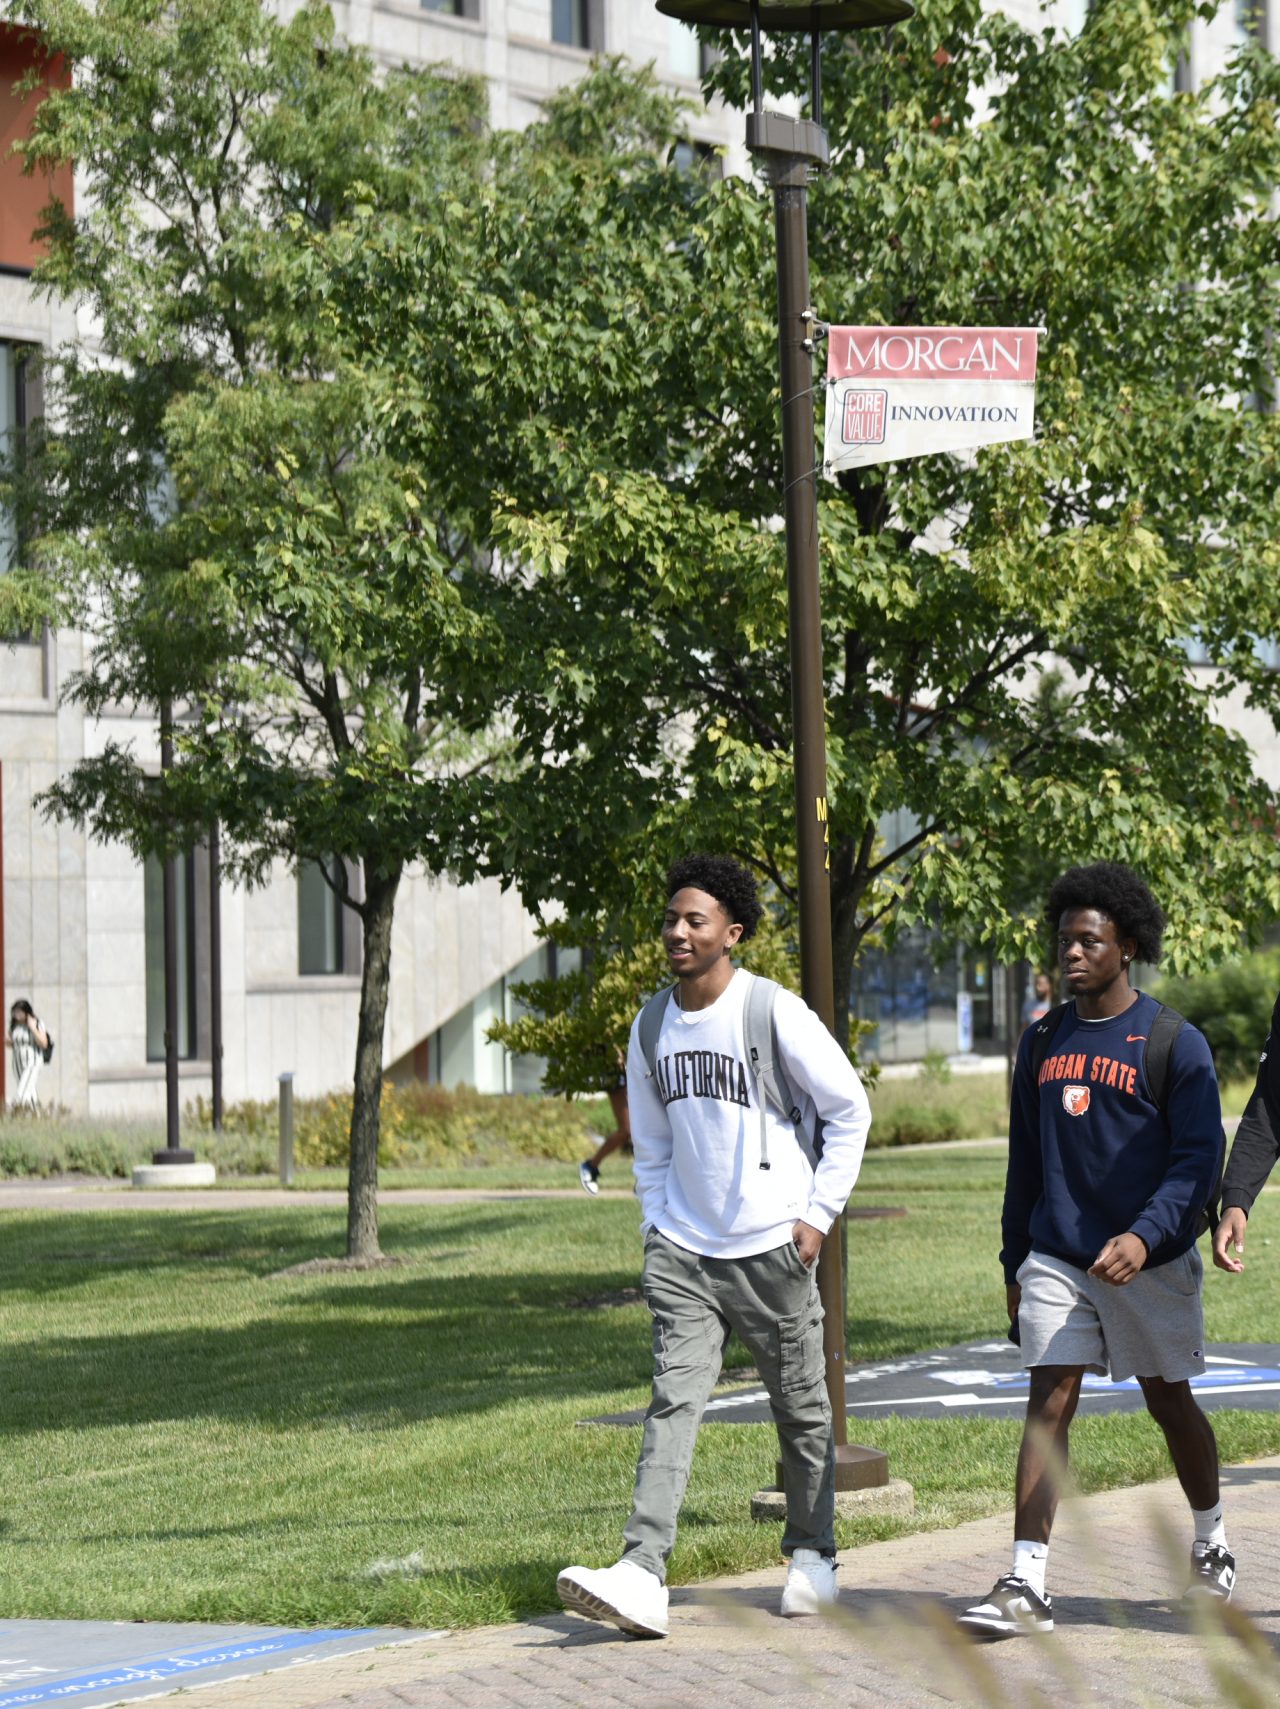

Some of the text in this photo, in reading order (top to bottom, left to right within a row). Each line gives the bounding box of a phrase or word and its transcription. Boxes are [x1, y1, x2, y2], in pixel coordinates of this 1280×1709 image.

[844, 335, 1023, 372] MORGAN
[848, 393, 882, 412] CORE
[890, 405, 1019, 423] INNOVATION
[847, 412, 882, 440] VALUE
[656, 1050, 751, 1109] ALIFORNIA
[1038, 1053, 1137, 1096] ORGAN STATE
